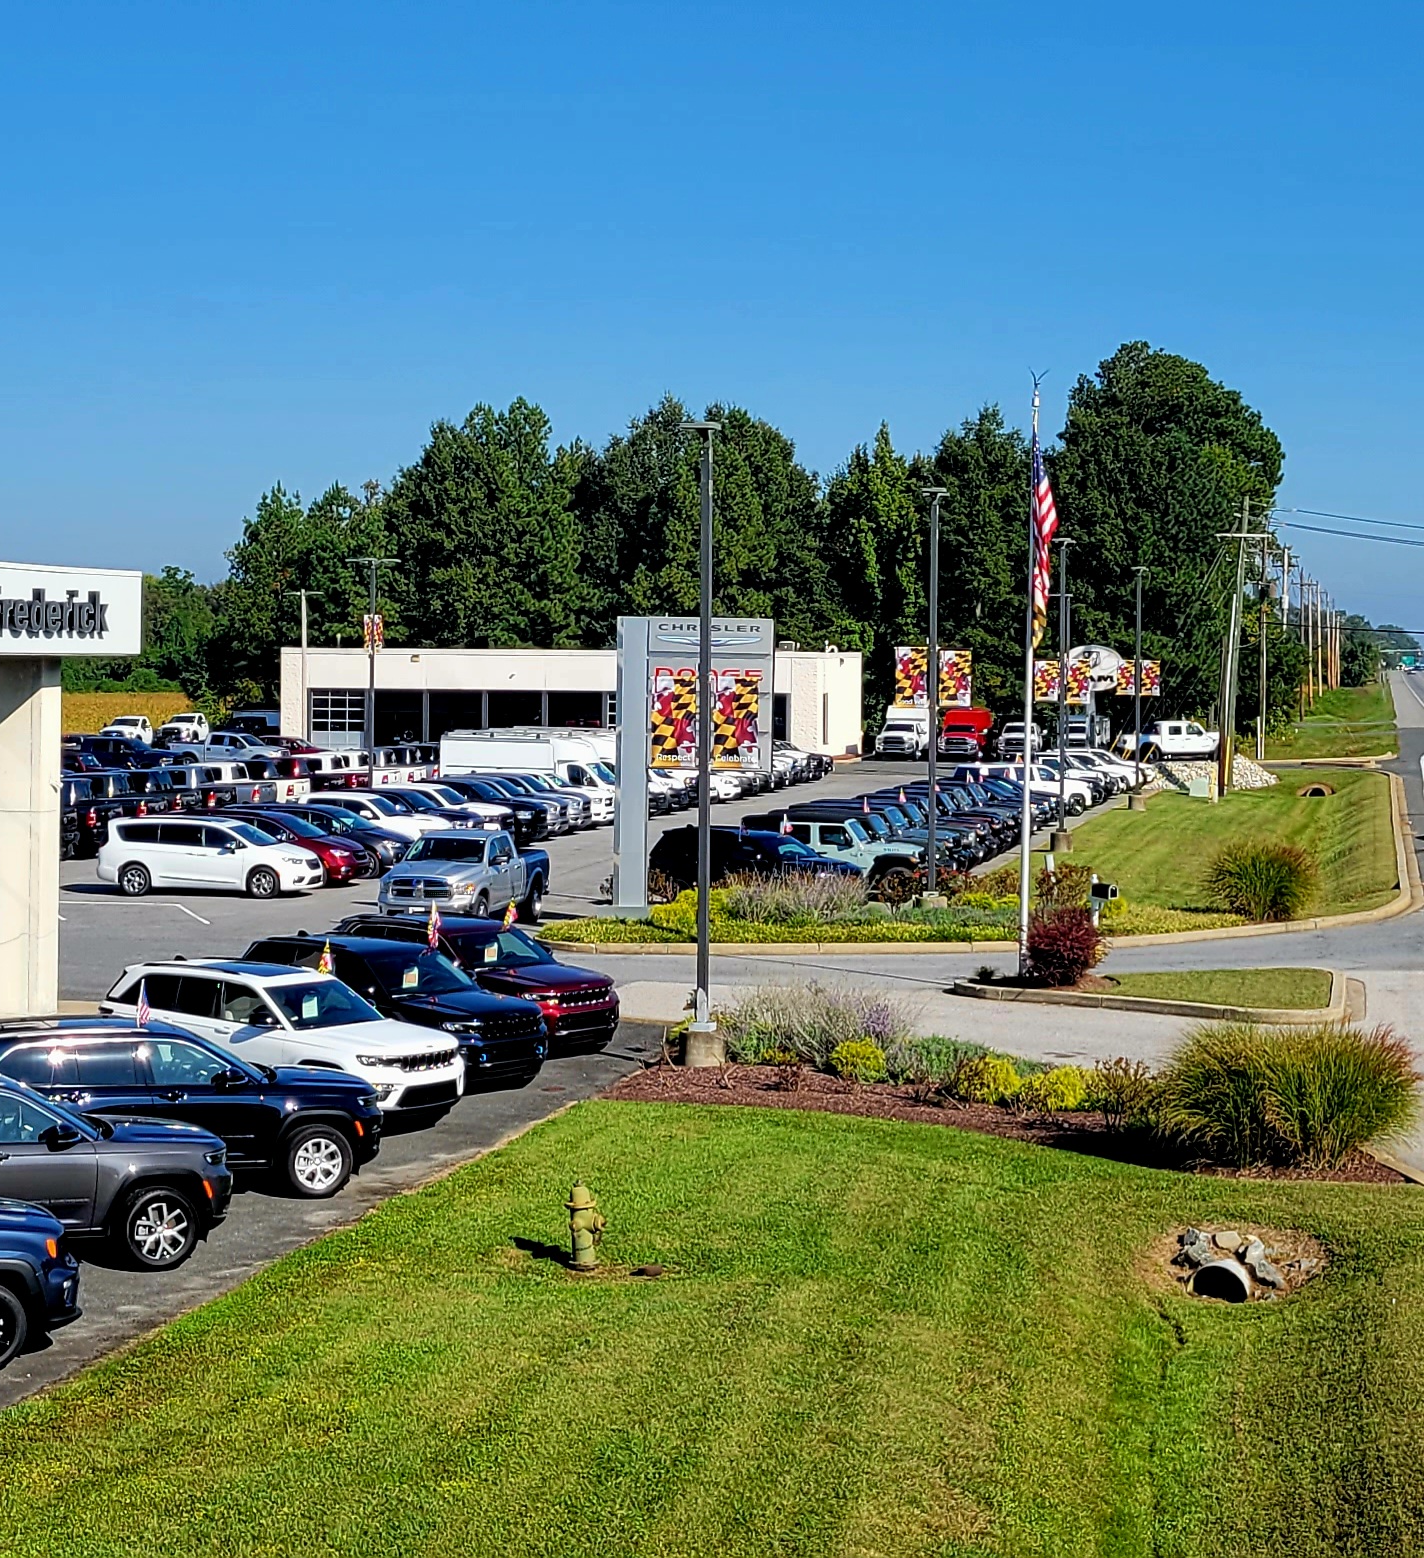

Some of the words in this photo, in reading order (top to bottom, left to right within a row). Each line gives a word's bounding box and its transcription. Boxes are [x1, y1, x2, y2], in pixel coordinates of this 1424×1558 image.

[658, 623, 761, 633] CHRSLER
[657, 753, 691, 763] Respect
[715, 753, 756, 763] Celebrate
